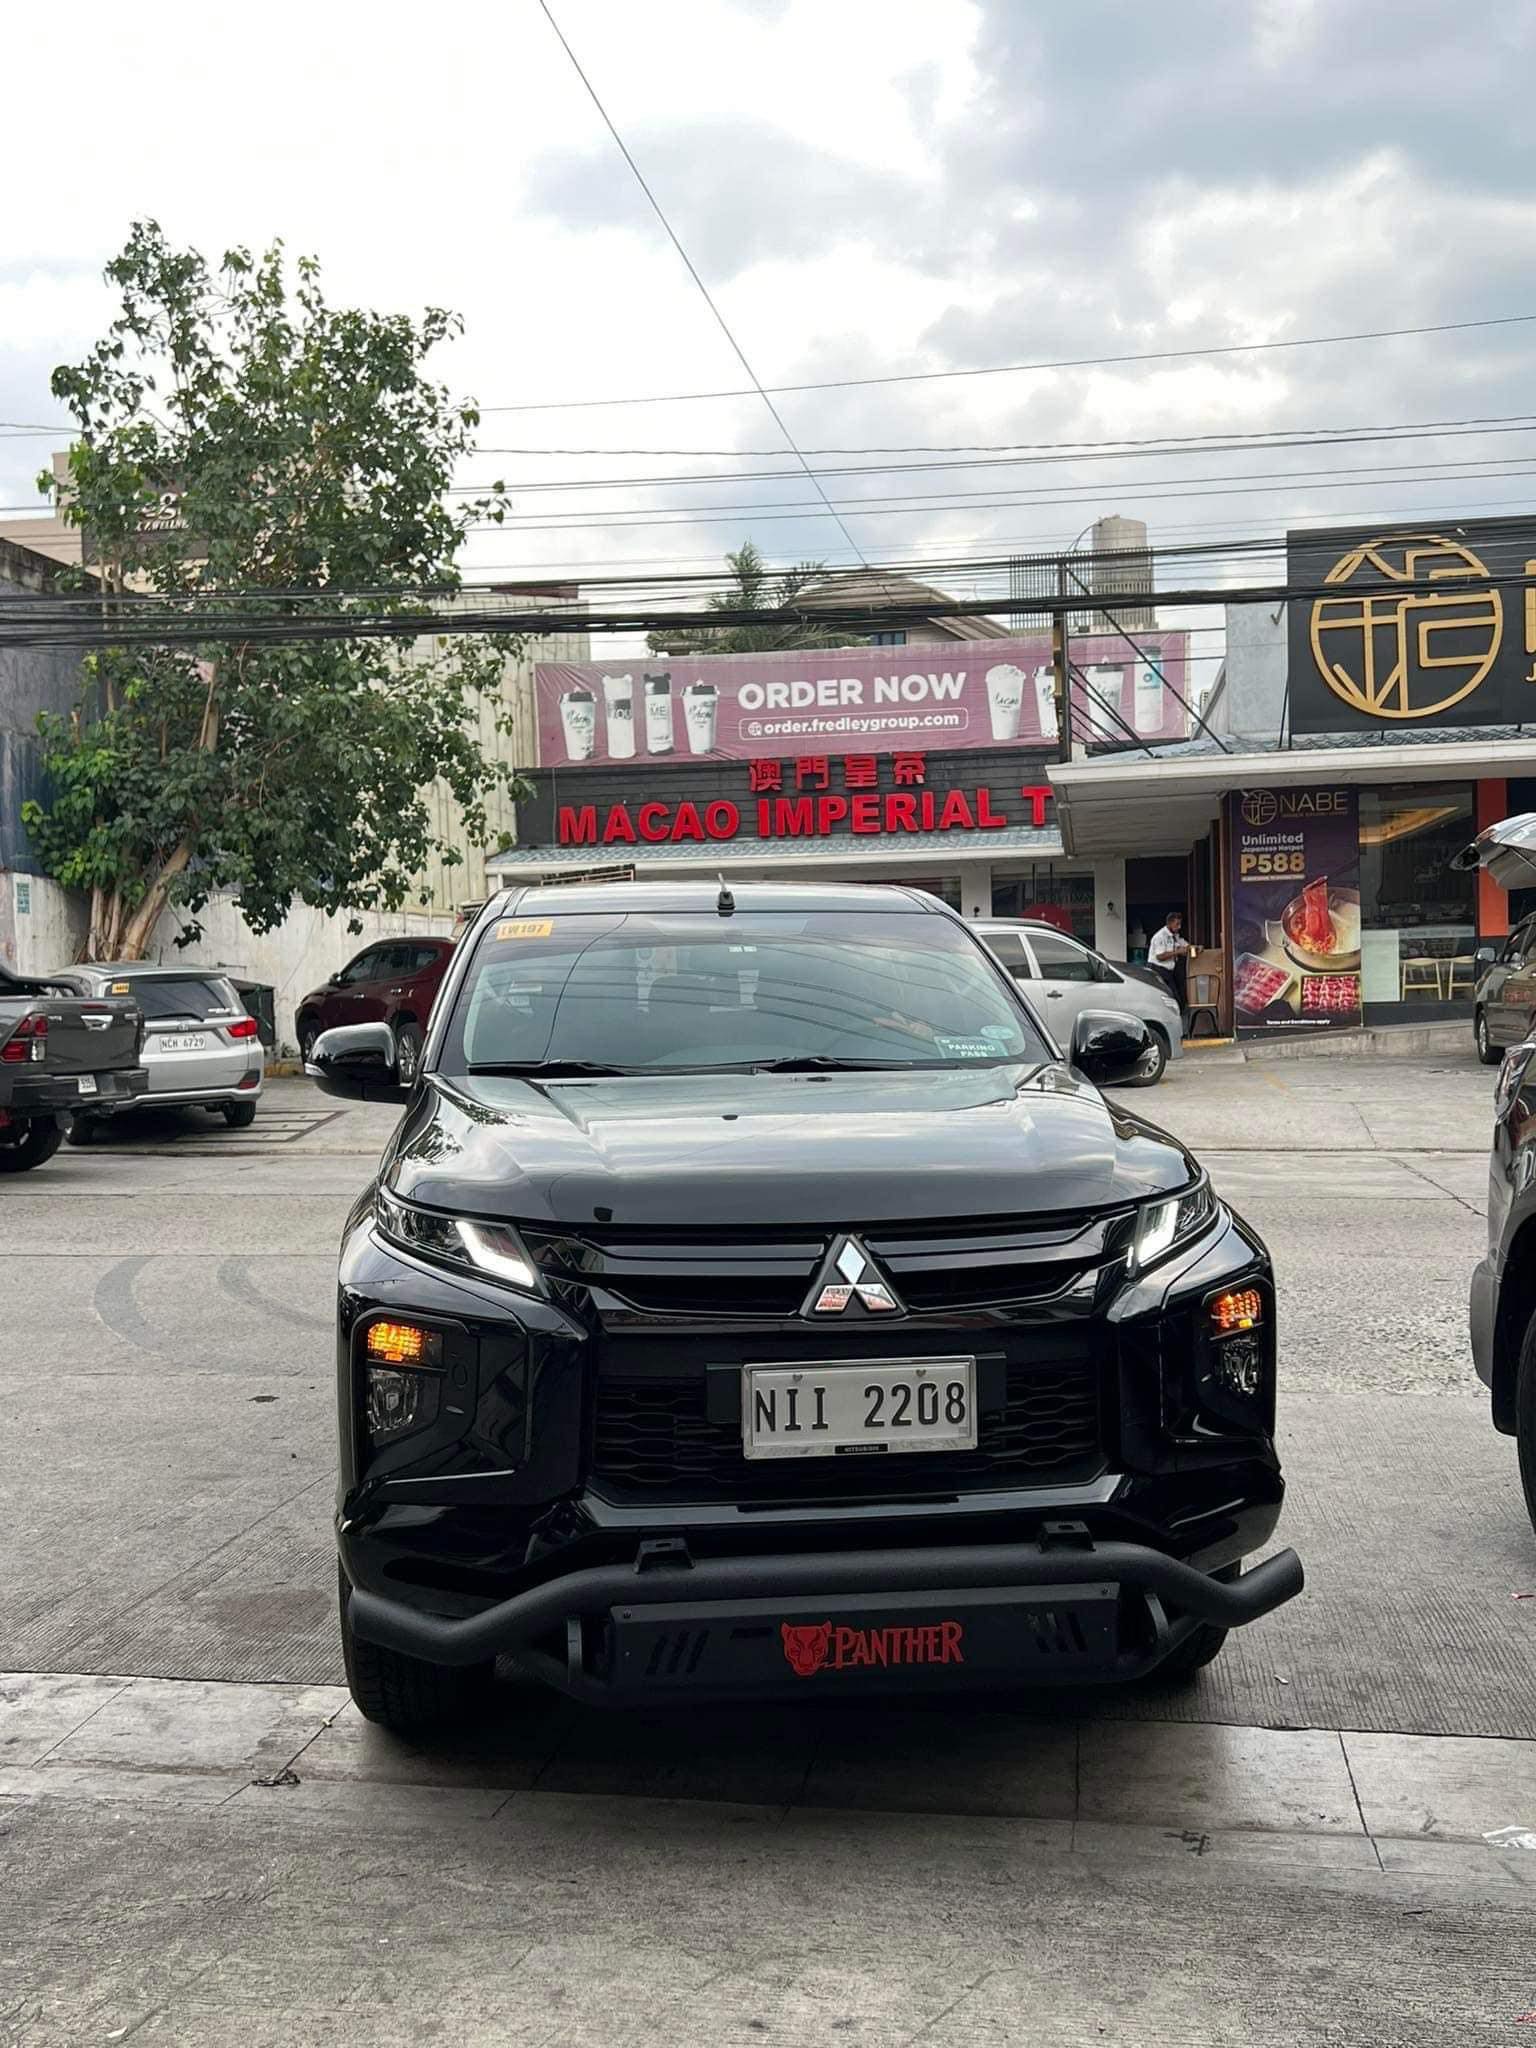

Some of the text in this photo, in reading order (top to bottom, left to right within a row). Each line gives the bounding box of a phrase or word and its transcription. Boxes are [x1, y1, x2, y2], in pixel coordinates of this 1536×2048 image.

[737, 672, 967, 711] ORDER NOW
[764, 712, 960, 735] order.fredleygroup.com
[1280, 791, 1349, 813] NABE
[559, 800, 740, 845] MACAO
[758, 787, 1007, 837] IMPERIAL
[1241, 832, 1304, 846] Unlimited
[1240, 852, 1305, 874] P588
[161, 1037, 205, 1049] NCH 6729
[947, 1043, 996, 1052] PARKING
[755, 1381, 966, 1433] NII 2208
[834, 1621, 965, 1669] PANTHER
